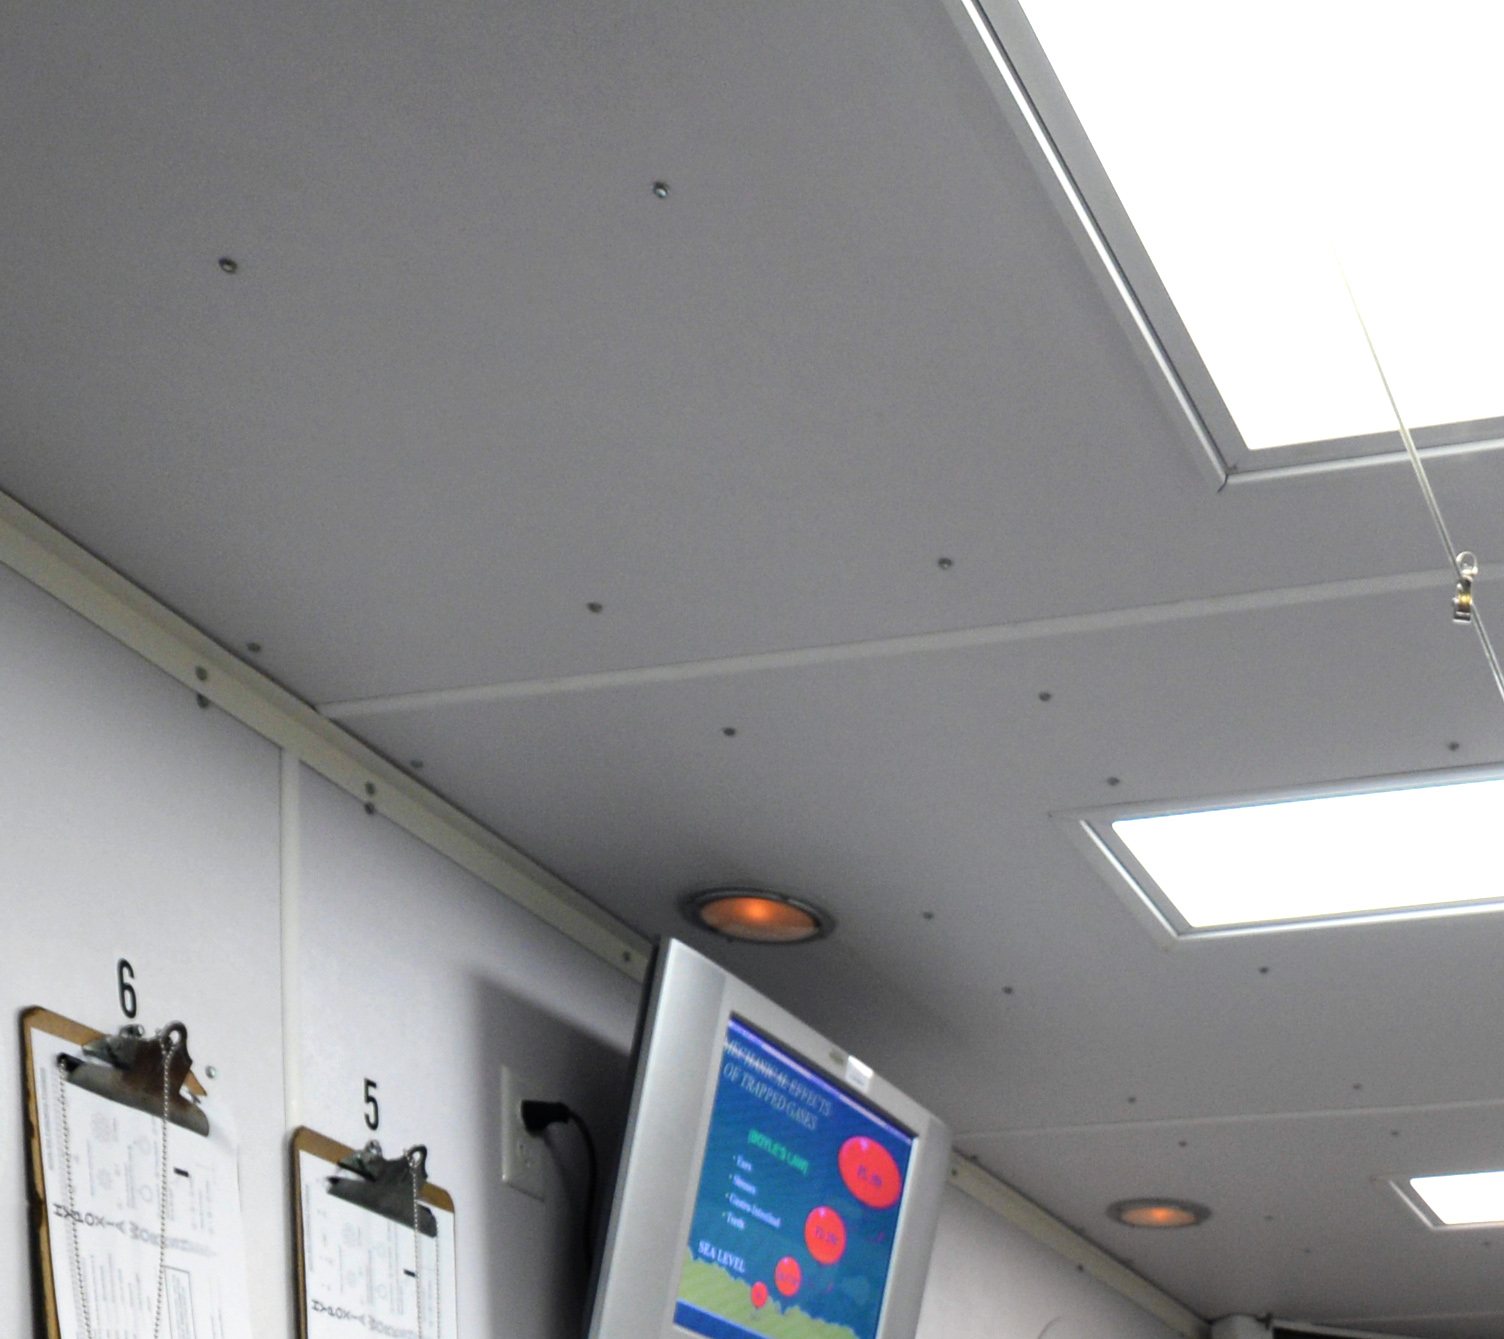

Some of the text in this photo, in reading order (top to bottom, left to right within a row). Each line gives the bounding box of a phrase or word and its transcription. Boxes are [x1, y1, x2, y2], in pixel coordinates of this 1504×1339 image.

[116, 957, 138, 1019] 6
[363, 1078, 380, 1131] 5
[723, 1062, 817, 1130] OF TRAPPED GASES
[788, 1080, 832, 1116] EFFECTS
[699, 1240, 745, 1274] SEA LEVEL
